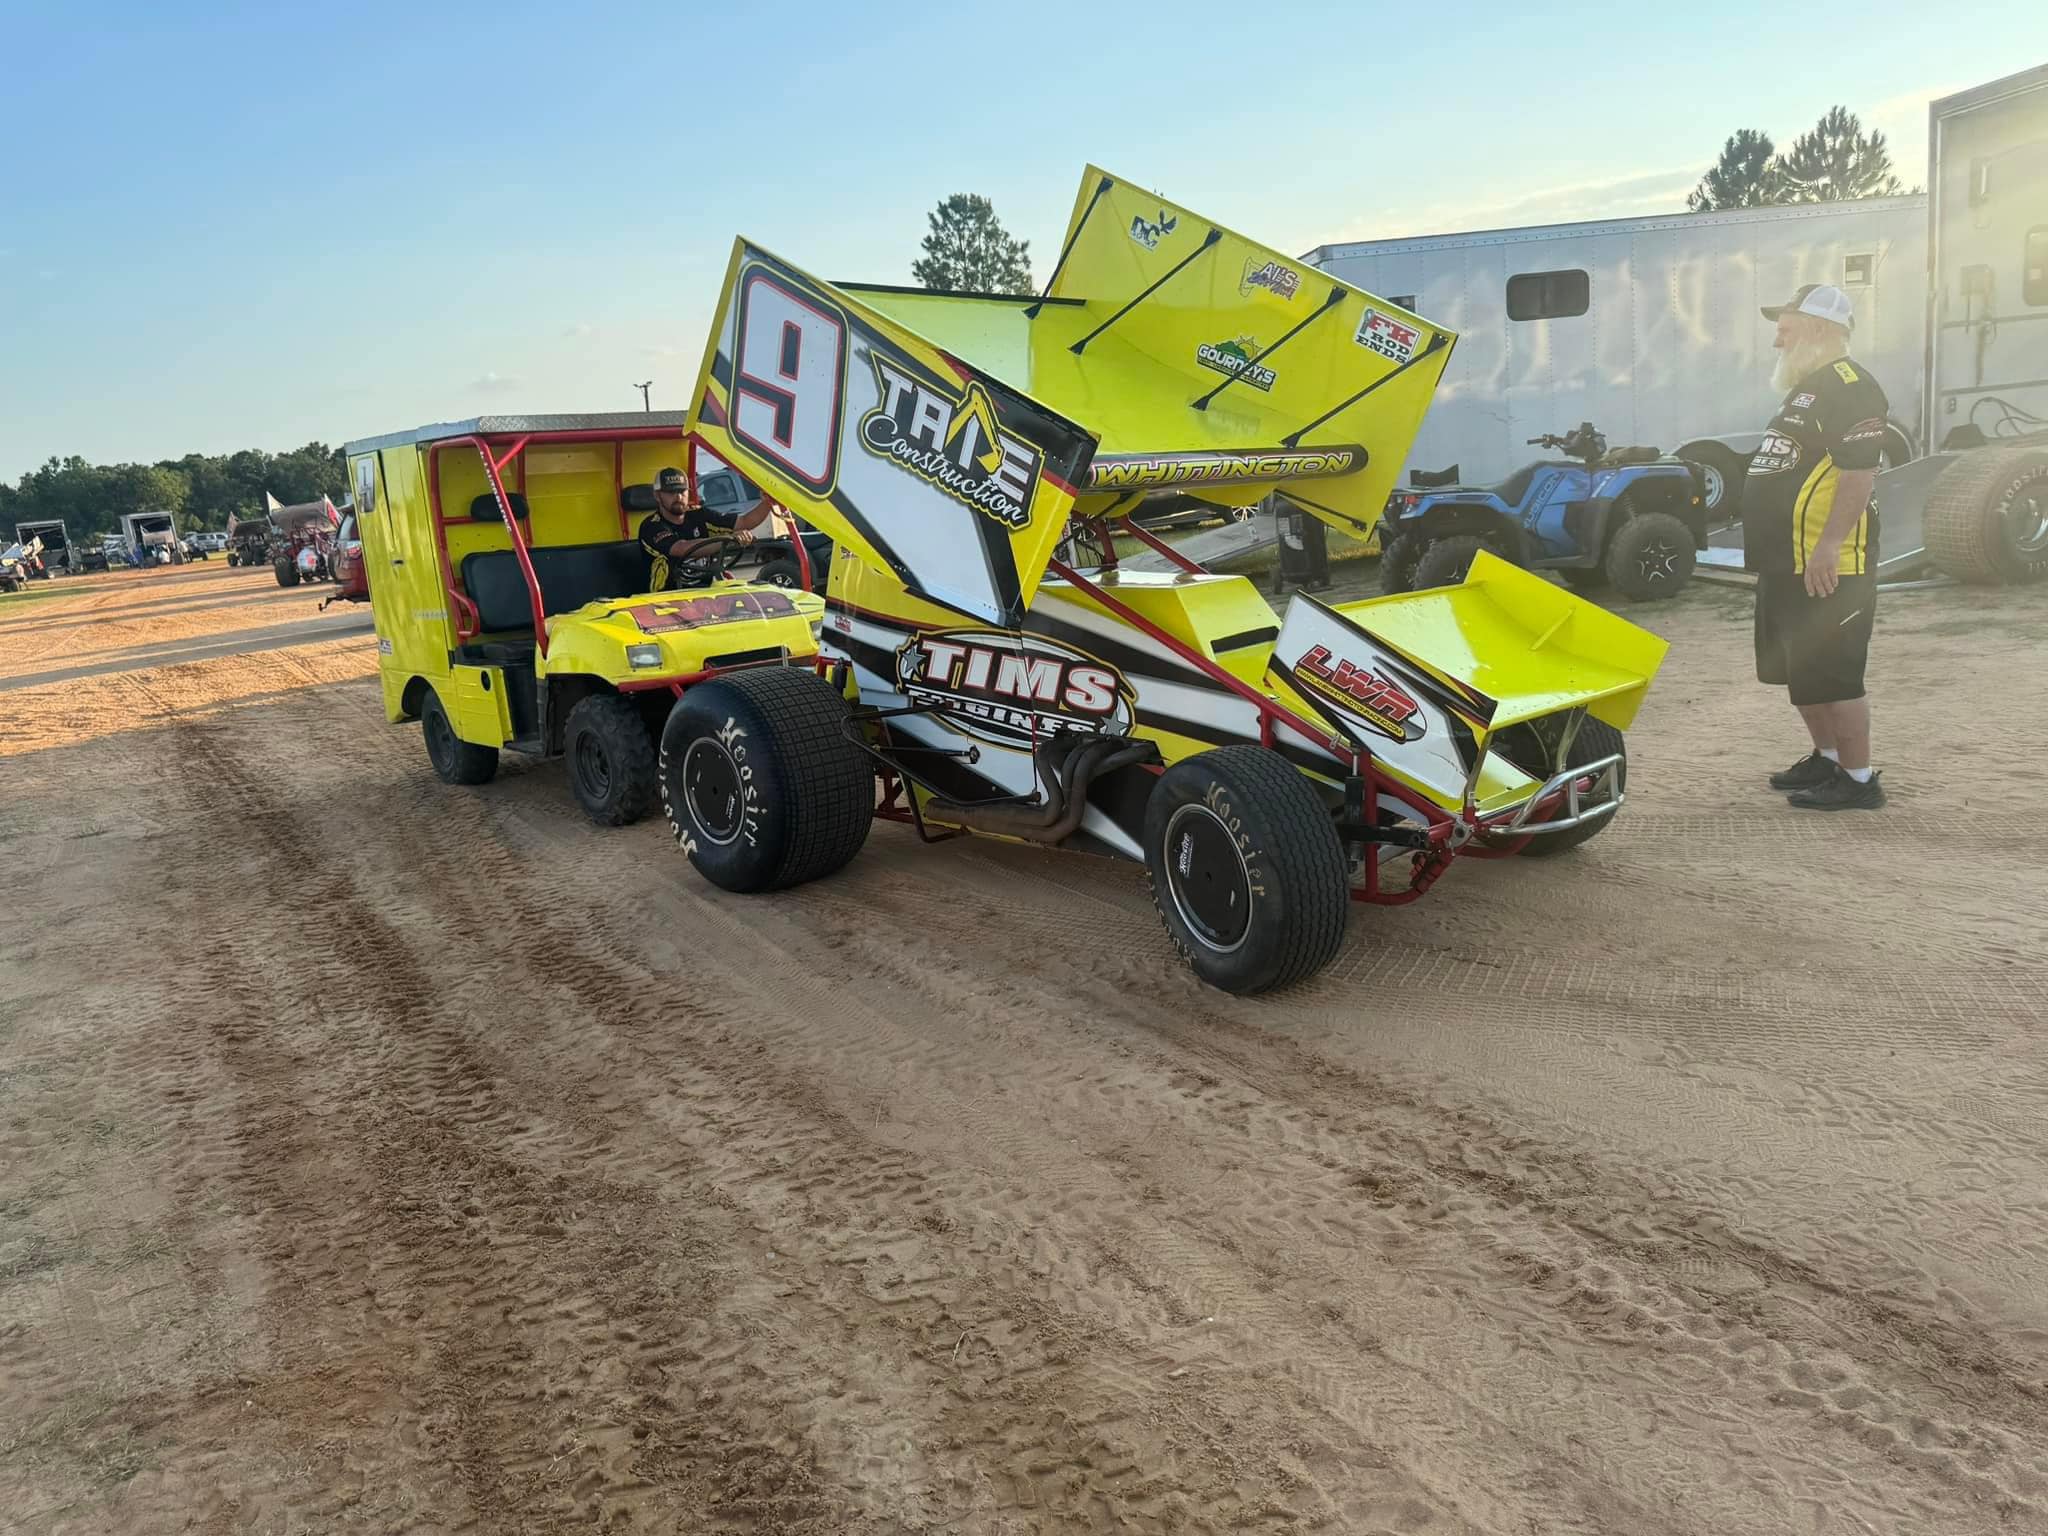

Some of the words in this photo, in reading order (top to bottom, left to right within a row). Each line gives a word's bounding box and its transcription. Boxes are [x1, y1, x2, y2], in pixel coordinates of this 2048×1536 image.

[1356, 335, 1407, 363] ENDS
[1368, 315, 1416, 347] FK
[1371, 331, 1409, 355] ROD
[735, 276, 841, 484] 9
[864, 414, 1026, 523] Construction
[1093, 452, 1352, 488] WHITTINGTON
[921, 640, 1117, 713] TIMS
[1300, 646, 1416, 720] LWR
